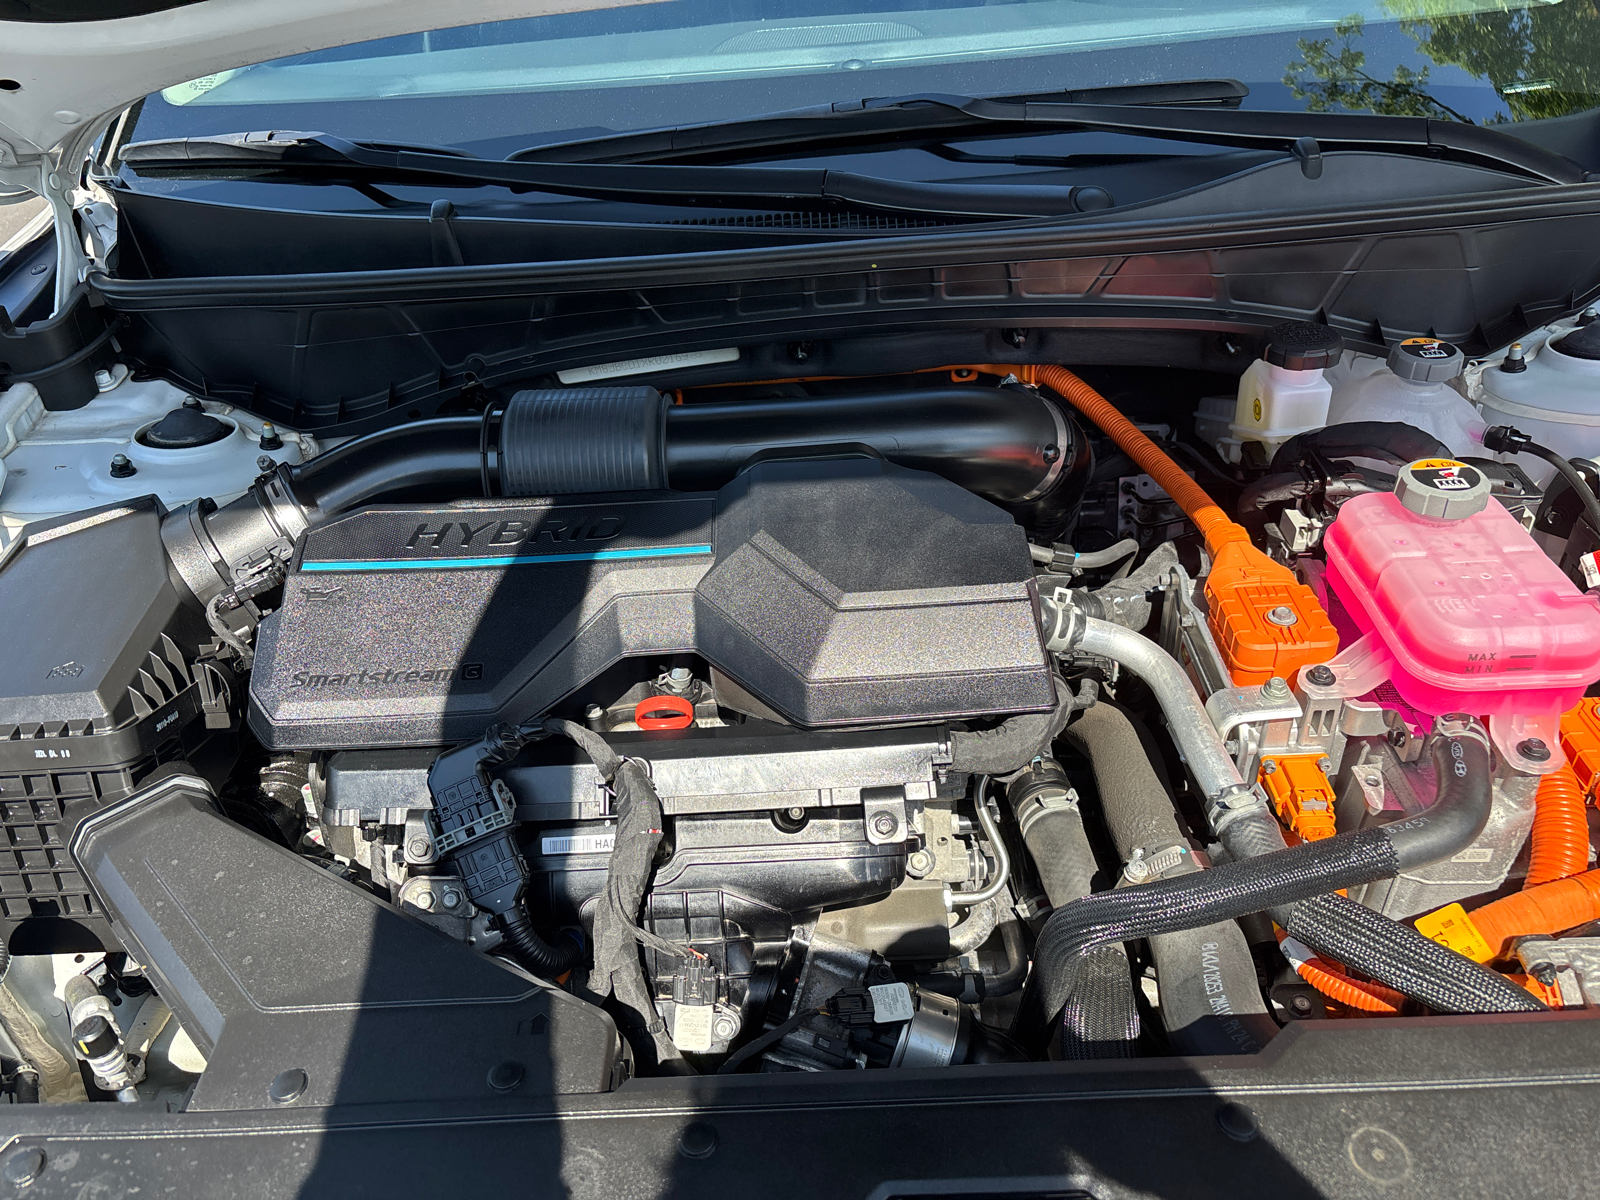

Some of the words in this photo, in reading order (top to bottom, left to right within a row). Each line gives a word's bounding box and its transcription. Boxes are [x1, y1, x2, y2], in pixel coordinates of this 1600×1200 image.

[406, 516, 624, 549] HYBRID
[1468, 653, 1497, 662] MAX
[291, 665, 456, 689] Smartstream
[1465, 665, 1494, 674] MIN
[1387, 817, 1431, 834] 63459
[1203, 971, 1224, 996] 28253
